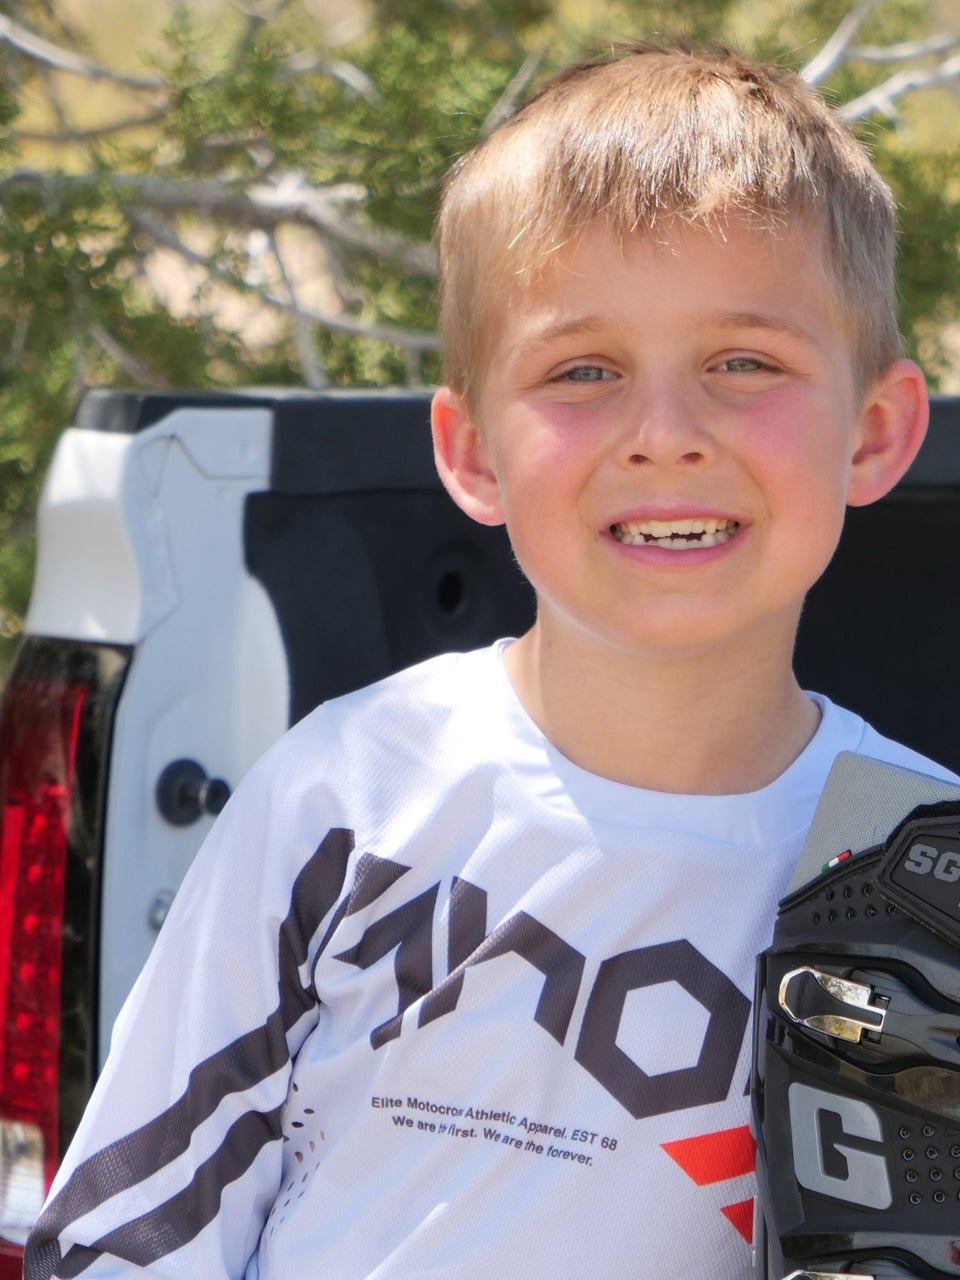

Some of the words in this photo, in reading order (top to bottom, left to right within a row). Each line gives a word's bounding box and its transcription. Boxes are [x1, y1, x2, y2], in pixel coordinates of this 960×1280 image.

[332, 874, 753, 1120] THO
[371, 1096, 403, 1109] Elite
[465, 1107, 517, 1125] Athletic
[571, 1129, 598, 1145] EST
[600, 1136, 618, 1151] 68
[392, 1115, 414, 1128] We
[417, 1120, 436, 1133] are
[448, 1124, 477, 1138] first.
[483, 1127, 501, 1142] We
[502, 1134, 522, 1149] are
[524, 1140, 544, 1155] the
[546, 1145, 593, 1166] forever.
[788, 1082, 893, 1210] G
